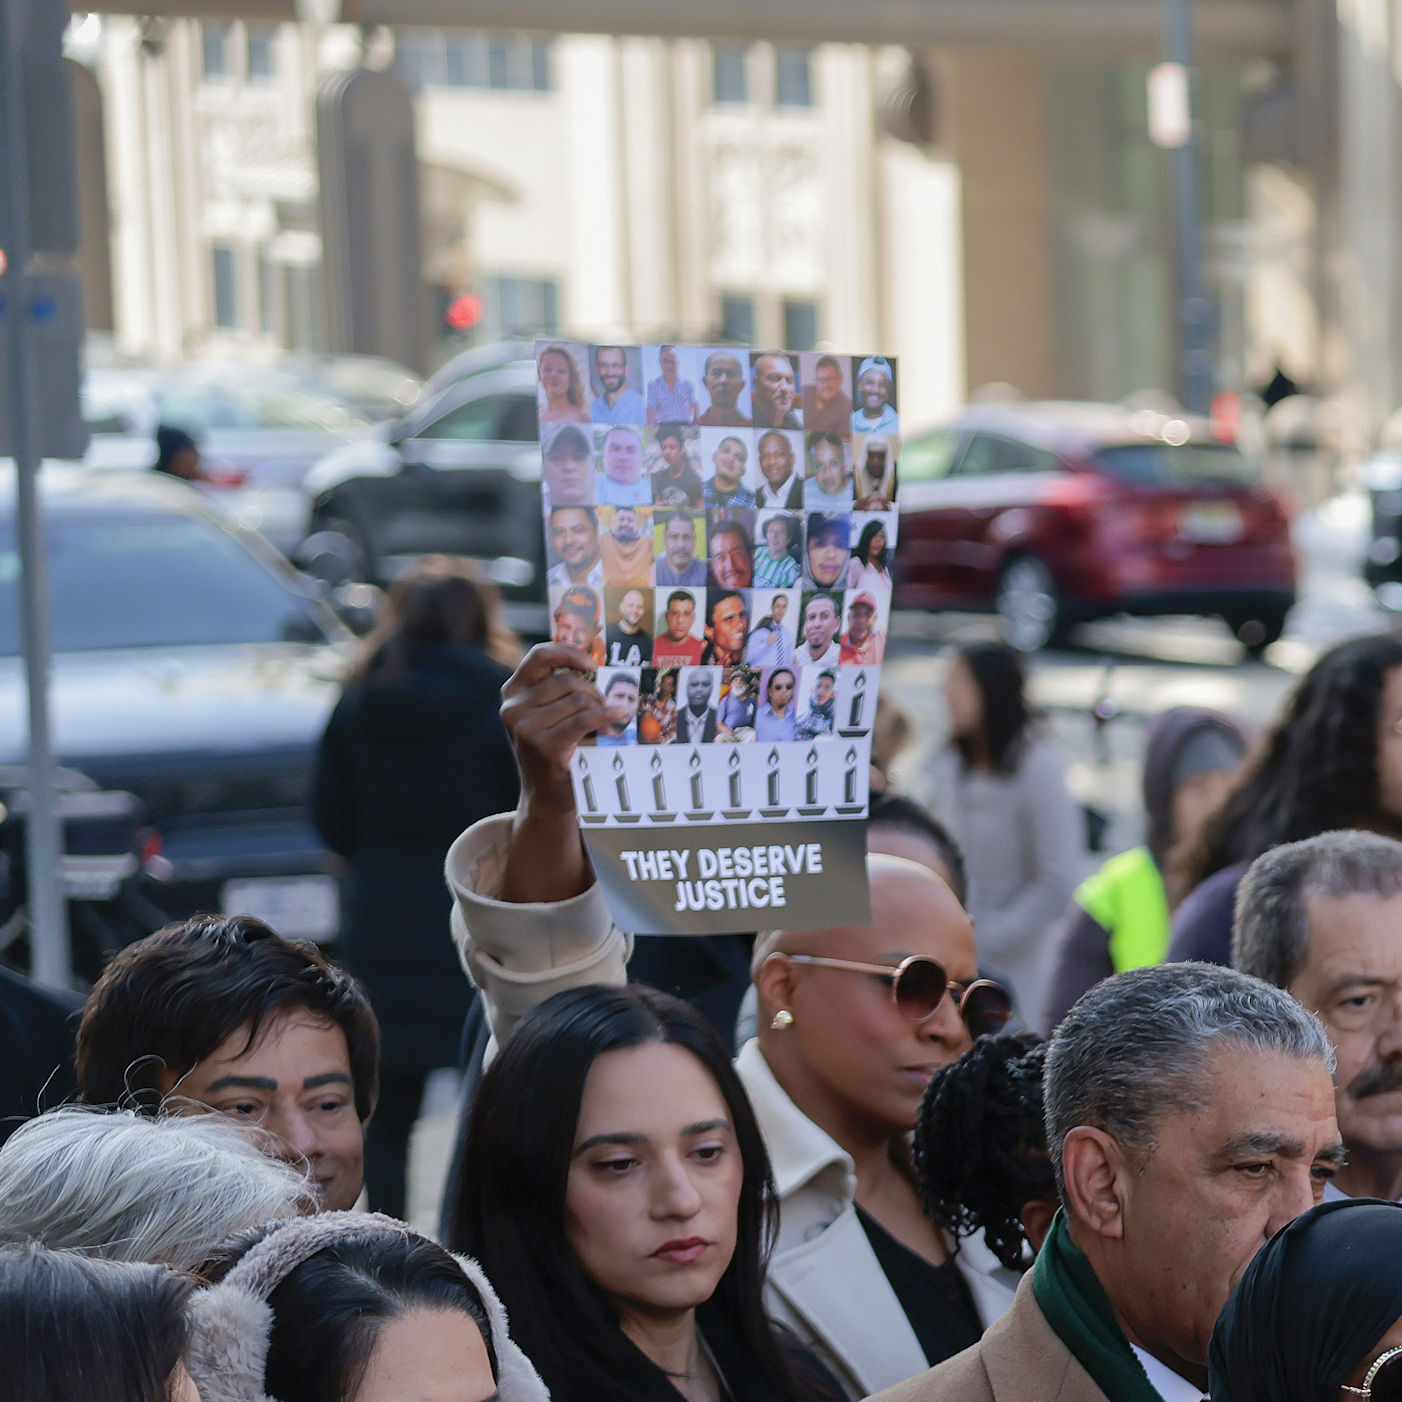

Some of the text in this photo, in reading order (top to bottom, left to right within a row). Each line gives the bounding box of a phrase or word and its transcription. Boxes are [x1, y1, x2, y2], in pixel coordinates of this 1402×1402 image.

[619, 843, 824, 881] THEY DESERVE
[675, 876, 786, 911] JUSTICE
